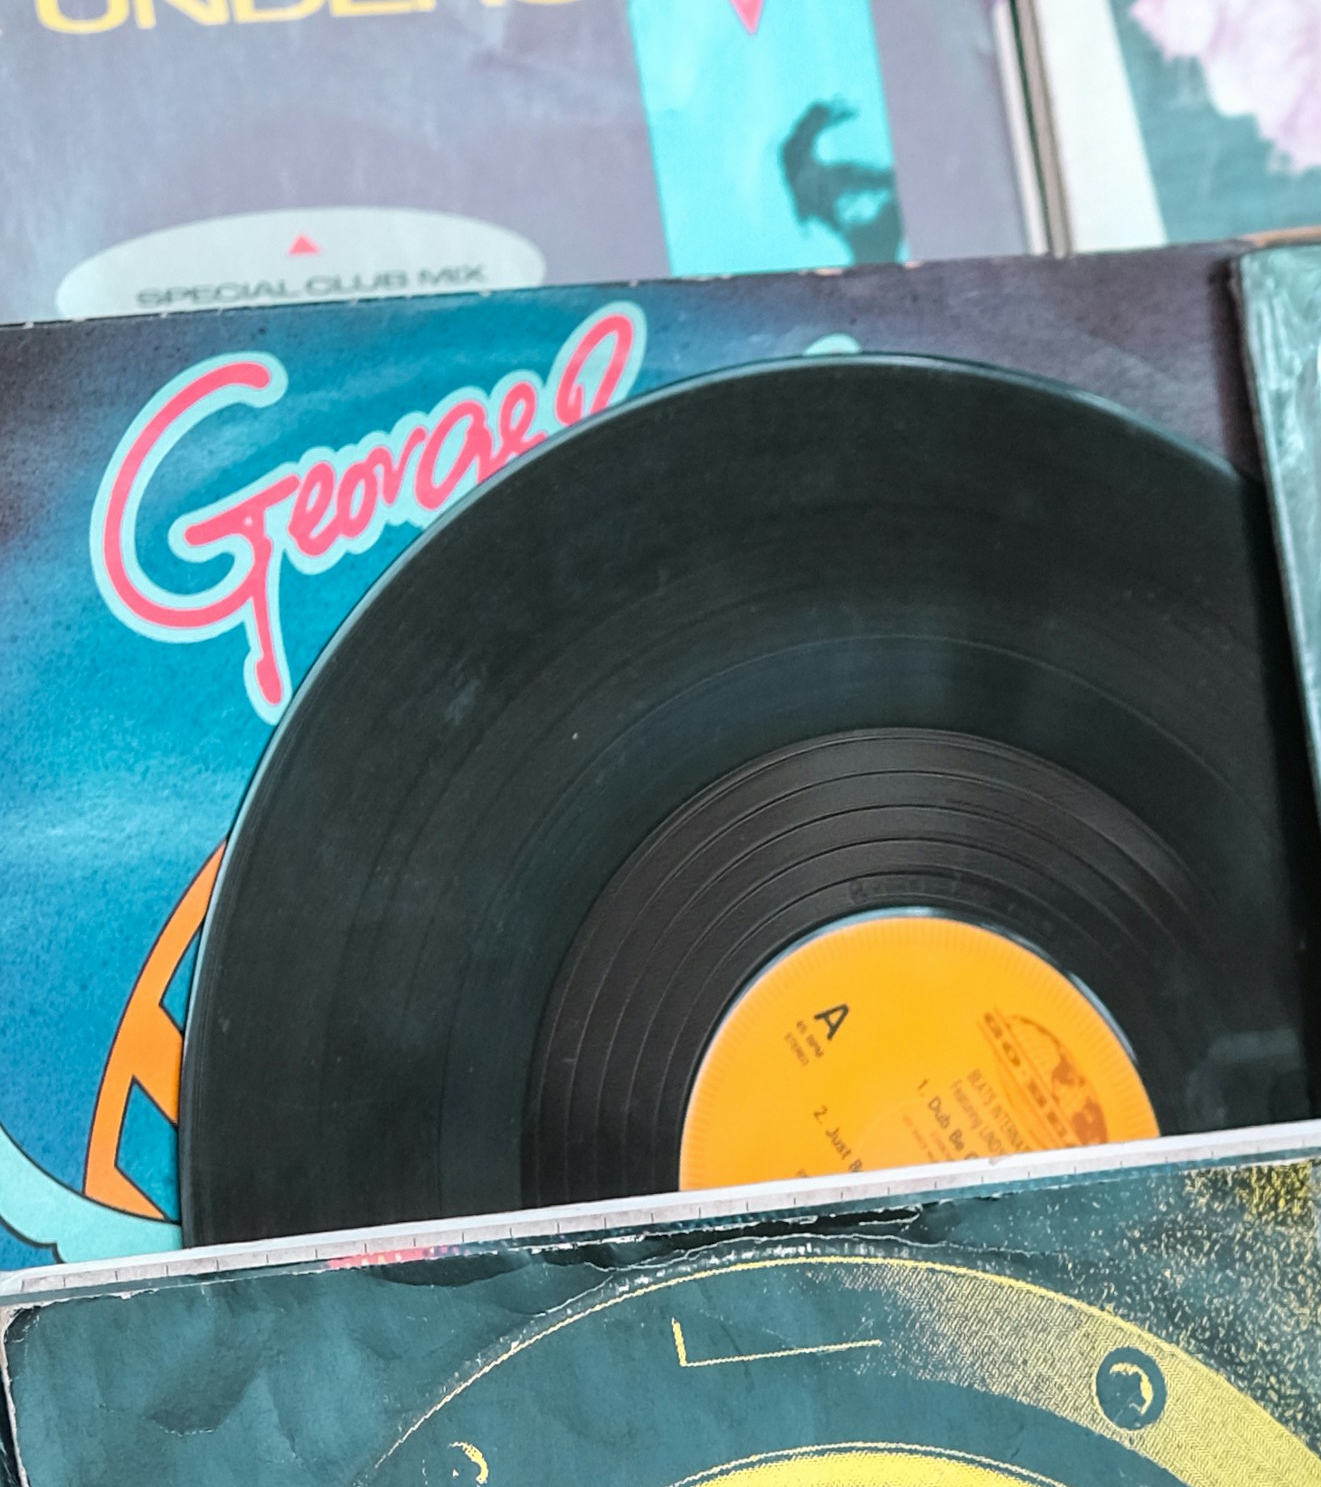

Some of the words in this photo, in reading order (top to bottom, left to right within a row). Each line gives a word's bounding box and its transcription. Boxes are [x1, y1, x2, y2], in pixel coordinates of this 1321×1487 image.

[137, 278, 299, 307] SPECIAL
[305, 270, 408, 295] CLUB
[418, 263, 486, 285] MIX
[814, 1003, 850, 1041] A
[928, 1095, 951, 1129] Dub
[825, 1126, 851, 1161] Just
